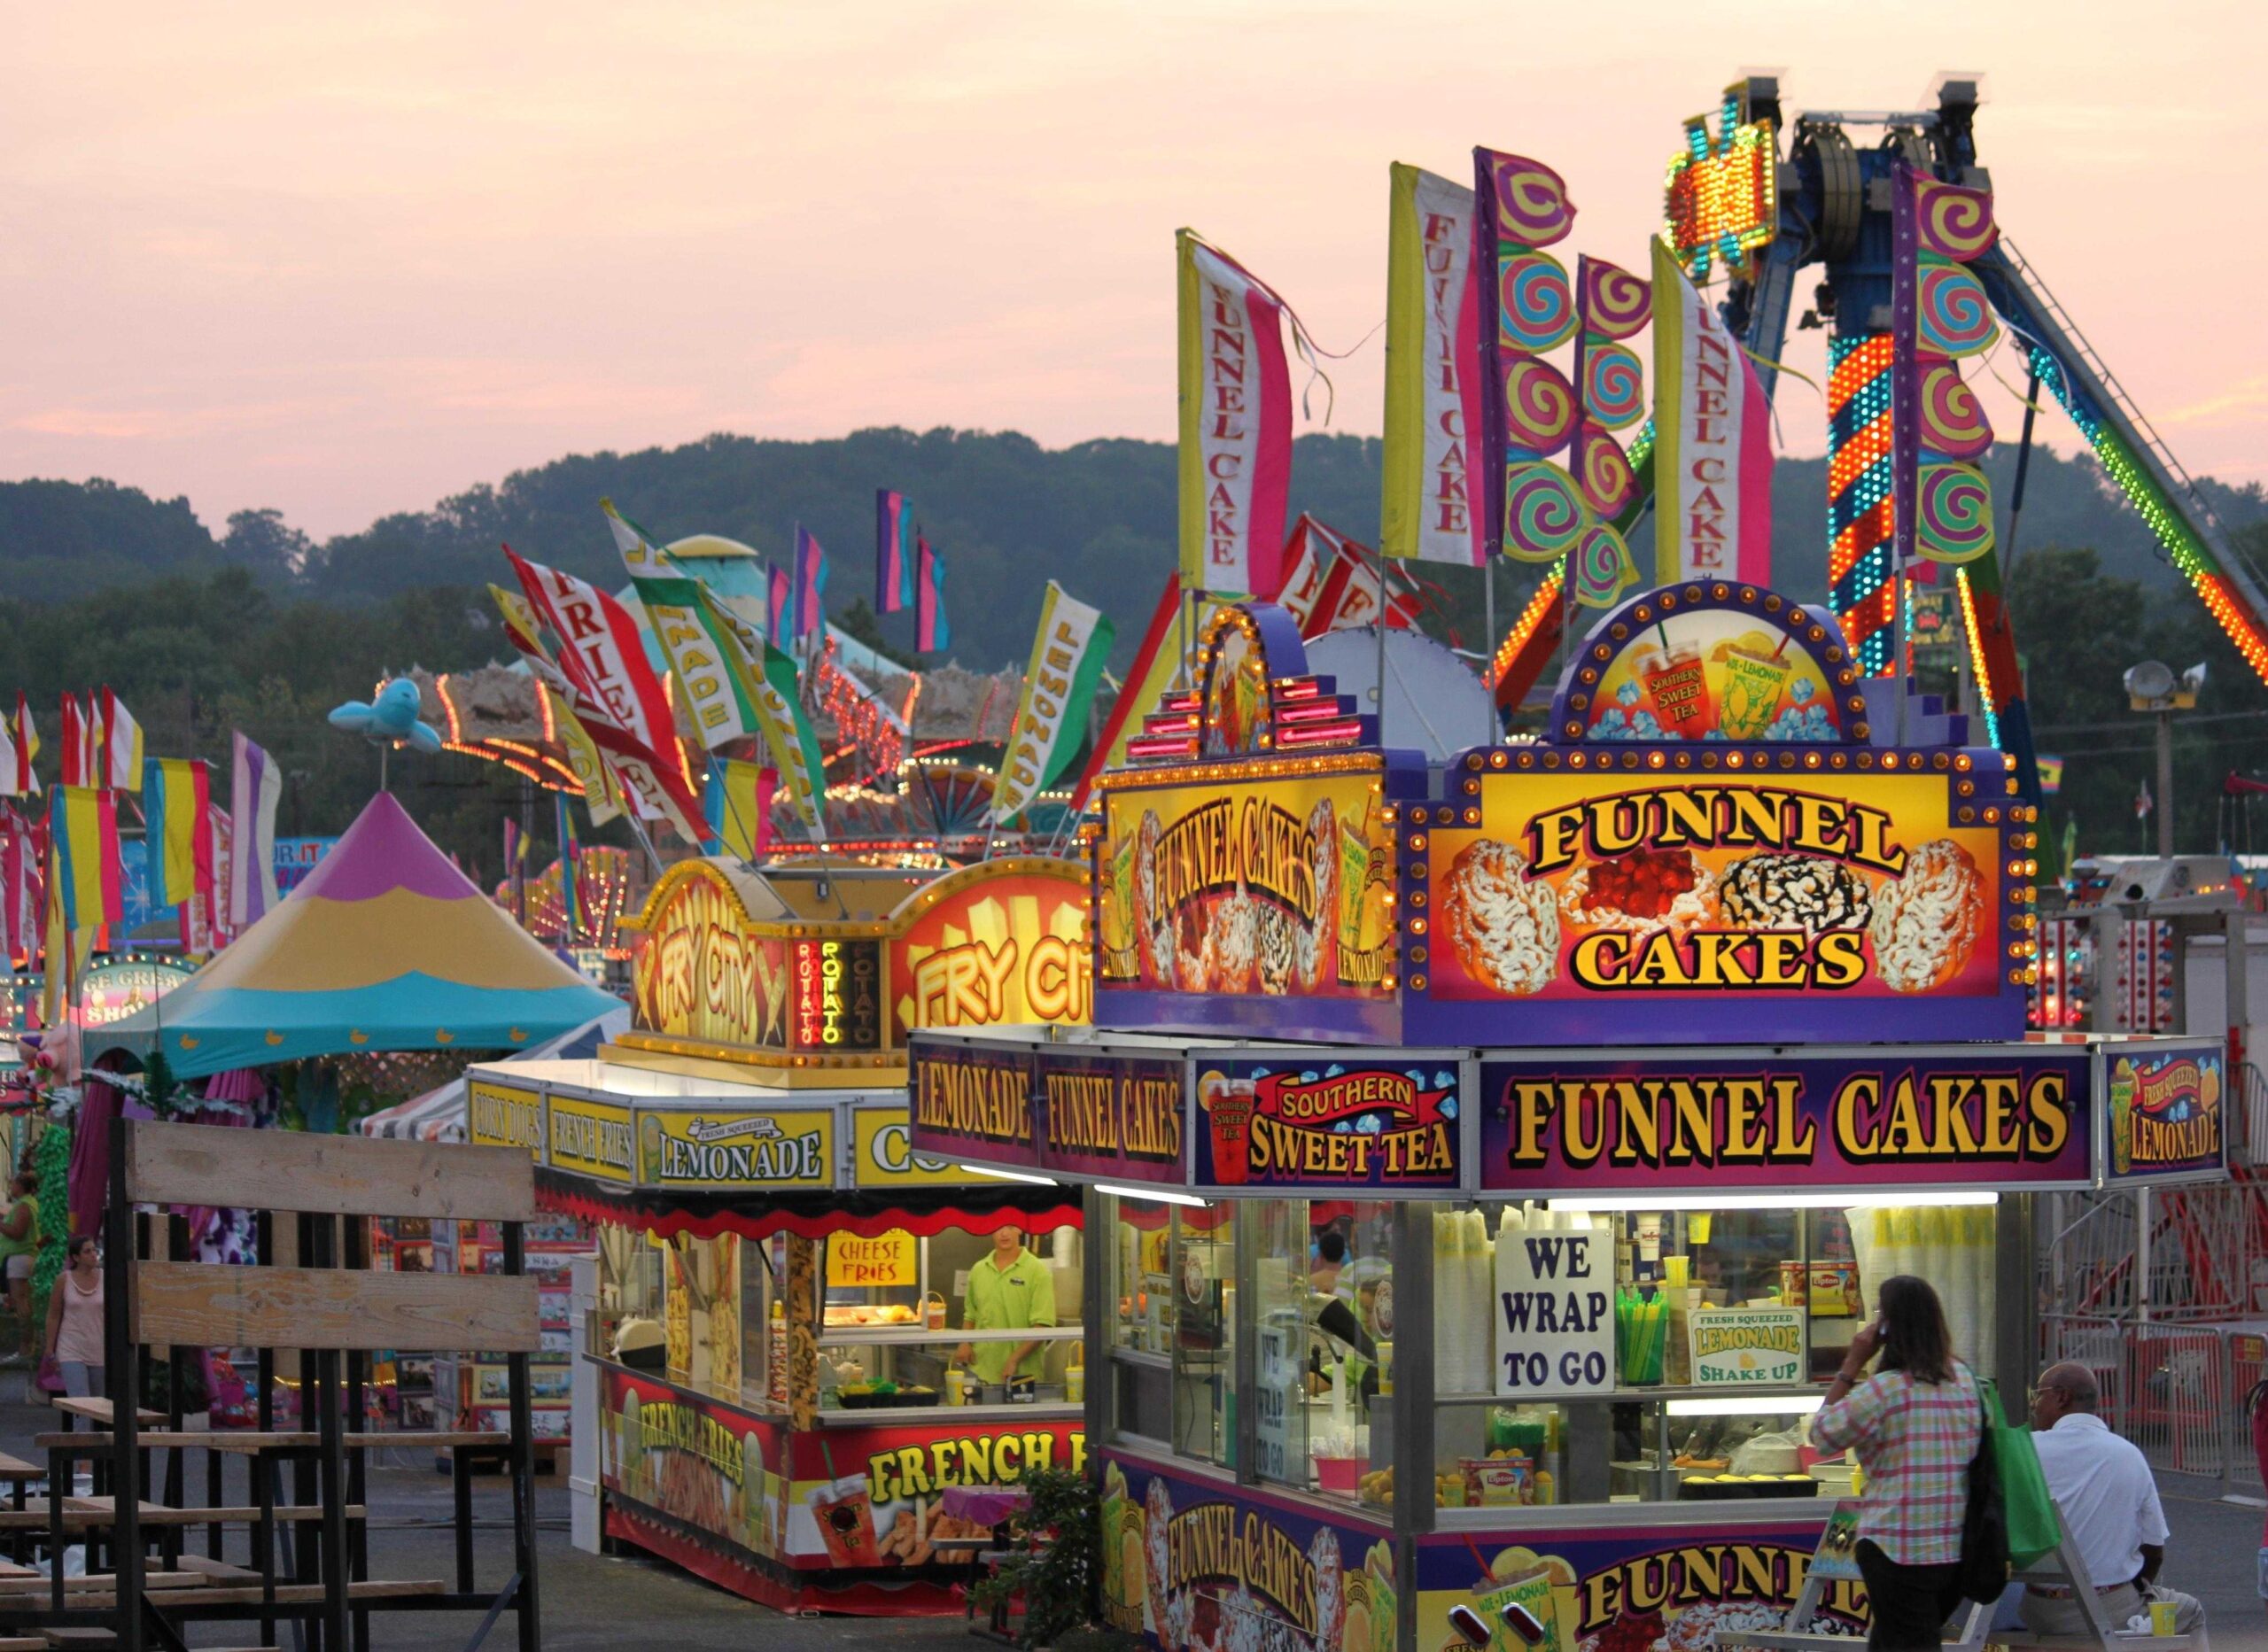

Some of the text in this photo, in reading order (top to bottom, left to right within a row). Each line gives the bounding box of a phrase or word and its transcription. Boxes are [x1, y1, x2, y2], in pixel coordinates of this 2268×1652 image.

[1689, 299, 1730, 569] UNNEL CAKE
[1433, 409, 1468, 535] CAKE
[1208, 452, 1240, 566] CAKE
[1651, 668, 1702, 694] SOUTHERN
[1658, 682, 1702, 708] SWEET
[1006, 620, 1079, 810] LEMONADE
[1672, 704, 1698, 723] TEA
[1528, 787, 1908, 878] FUNNEL
[1153, 799, 1317, 927] FUNNEL CAKES
[659, 921, 759, 1035] FRY CITY
[913, 936, 1017, 1029] FRY
[1572, 927, 1868, 990] CAKES
[822, 942, 843, 1043] POTATO
[915, 1059, 1032, 1143] LEMONADE
[1282, 1076, 1412, 1118] SOUTHERN
[2143, 1065, 2199, 1107] FRESH SQUEEZED
[474, 1090, 541, 1150] CORN DOGS
[553, 1109, 632, 1171] FRENCH FRIES
[702, 1118, 771, 1140] FRESH SQUEEZED
[1045, 1073, 1180, 1159] FUNNEL CAKES
[1215, 1113, 1247, 1126] SWEET
[1222, 1128, 1241, 1141] TEA
[1250, 1113, 1454, 1175] SWEET TEA
[1511, 1069, 2071, 1168] FUNNEL CAKES
[2130, 1105, 2220, 1162] LEMONADE
[658, 1129, 823, 1182] LEMONADE
[838, 1240, 901, 1261] CHEESE
[843, 1262, 897, 1283] FRIES
[1525, 1236, 1592, 1279] WE
[1813, 1276, 1840, 1287] Lipton
[1501, 1291, 1608, 1334] WRAP
[1699, 1315, 1794, 1325] FRESH SQUEEZED
[1503, 1351, 1607, 1387] TO GO
[1695, 1325, 1801, 1358] LEMONADE
[1699, 1361, 1798, 1383] SHAKE UP
[640, 1400, 745, 1487] FRENCH FRIES
[867, 1431, 1058, 1504] FRENCH
[1487, 1475, 1515, 1485] Lipton
[1168, 1504, 1318, 1640] FUNNEL CAKES
